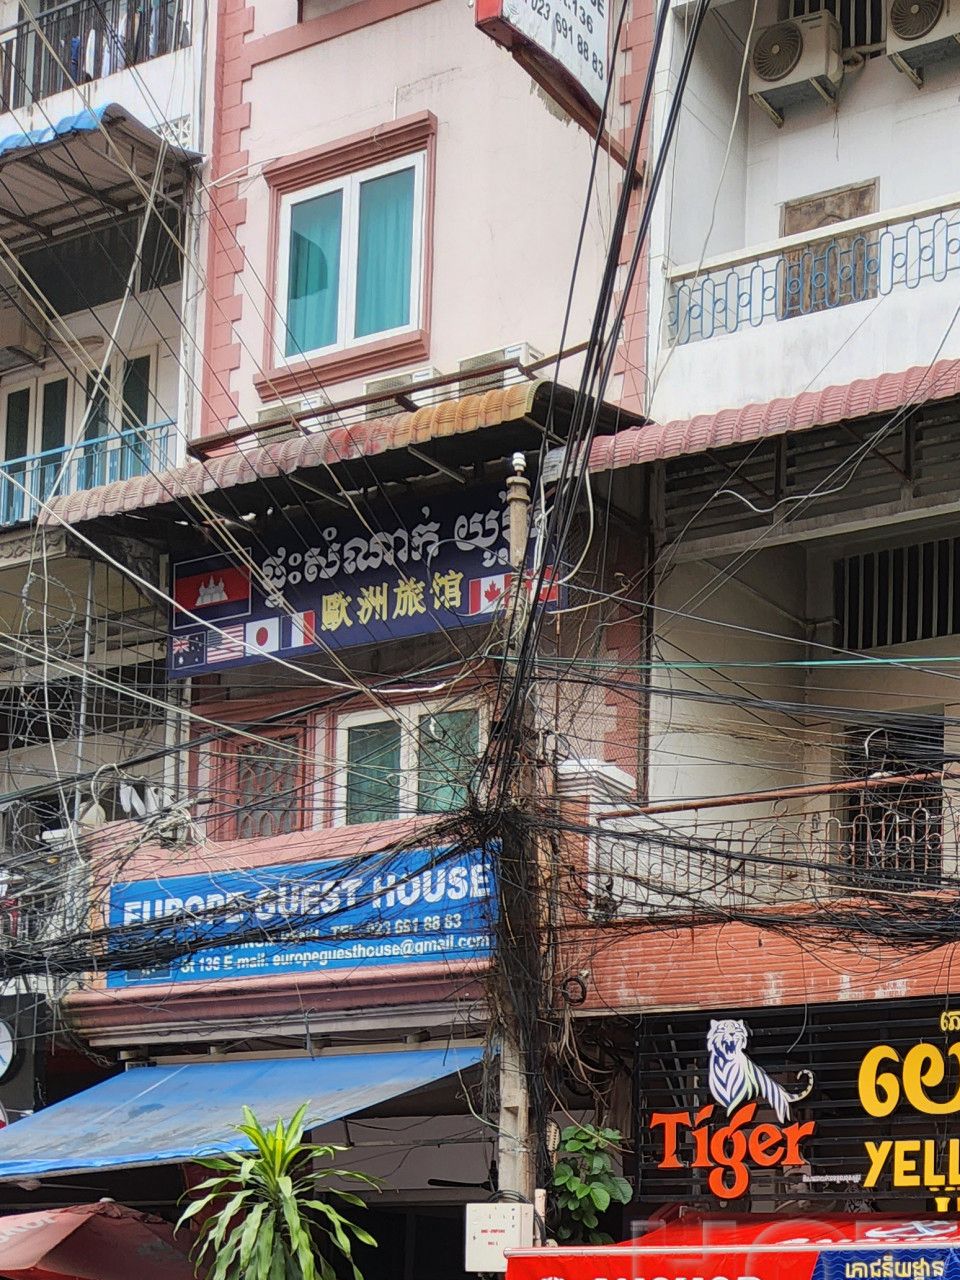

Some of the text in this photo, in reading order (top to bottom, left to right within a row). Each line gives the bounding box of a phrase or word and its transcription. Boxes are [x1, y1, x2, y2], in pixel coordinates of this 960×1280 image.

[554, 12, 574, 45] 691
[577, 33, 589, 61] 88
[592, 51, 604, 81] 83
[254, 878, 363, 921] GUEST
[371, 863, 491, 909] HOUSE
[199, 955, 221, 972] 136
[272, 934, 491, 967] europeguesthouse@gmail.com
[650, 1103, 816, 1200] Tiger
